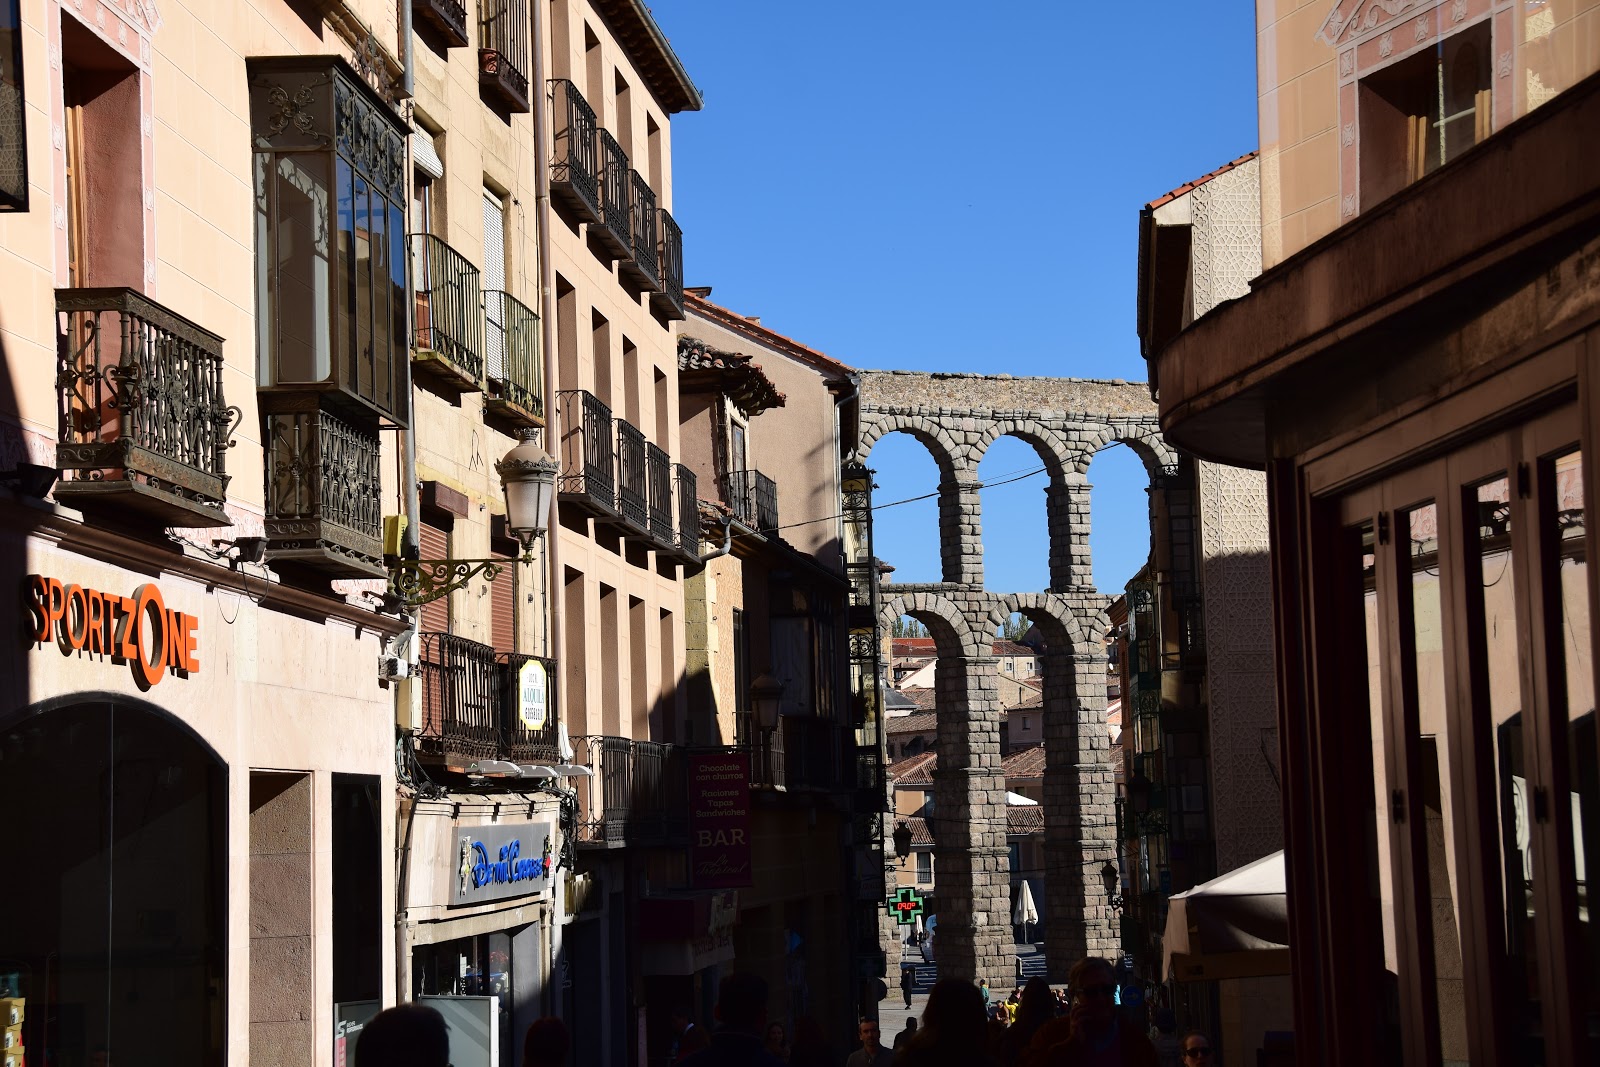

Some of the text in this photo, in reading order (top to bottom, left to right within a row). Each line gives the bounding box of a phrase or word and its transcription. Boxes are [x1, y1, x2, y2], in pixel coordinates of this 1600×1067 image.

[699, 763, 740, 773] Chocolate
[712, 772, 744, 781] churros
[701, 789, 740, 798] Raciones
[707, 799, 734, 808] Tapas
[696, 808, 746, 818] Sandwiches
[696, 828, 746, 848] BAR
